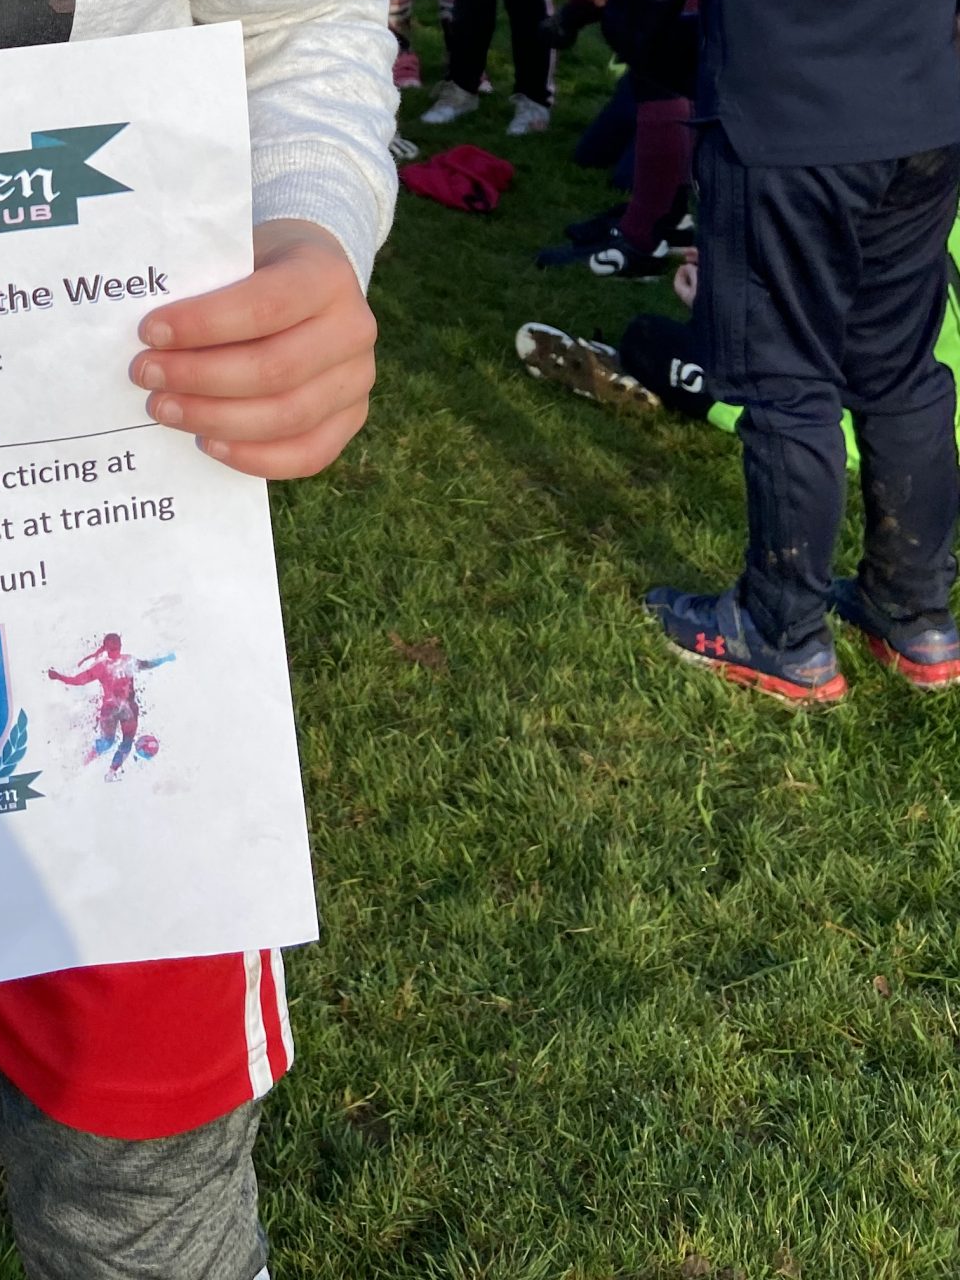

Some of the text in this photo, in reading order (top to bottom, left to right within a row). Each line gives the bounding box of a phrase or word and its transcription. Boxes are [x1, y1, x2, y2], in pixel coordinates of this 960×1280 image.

[62, 266, 170, 306] Week
[107, 450, 137, 474] at
[22, 511, 53, 537] at
[59, 496, 176, 531] training
